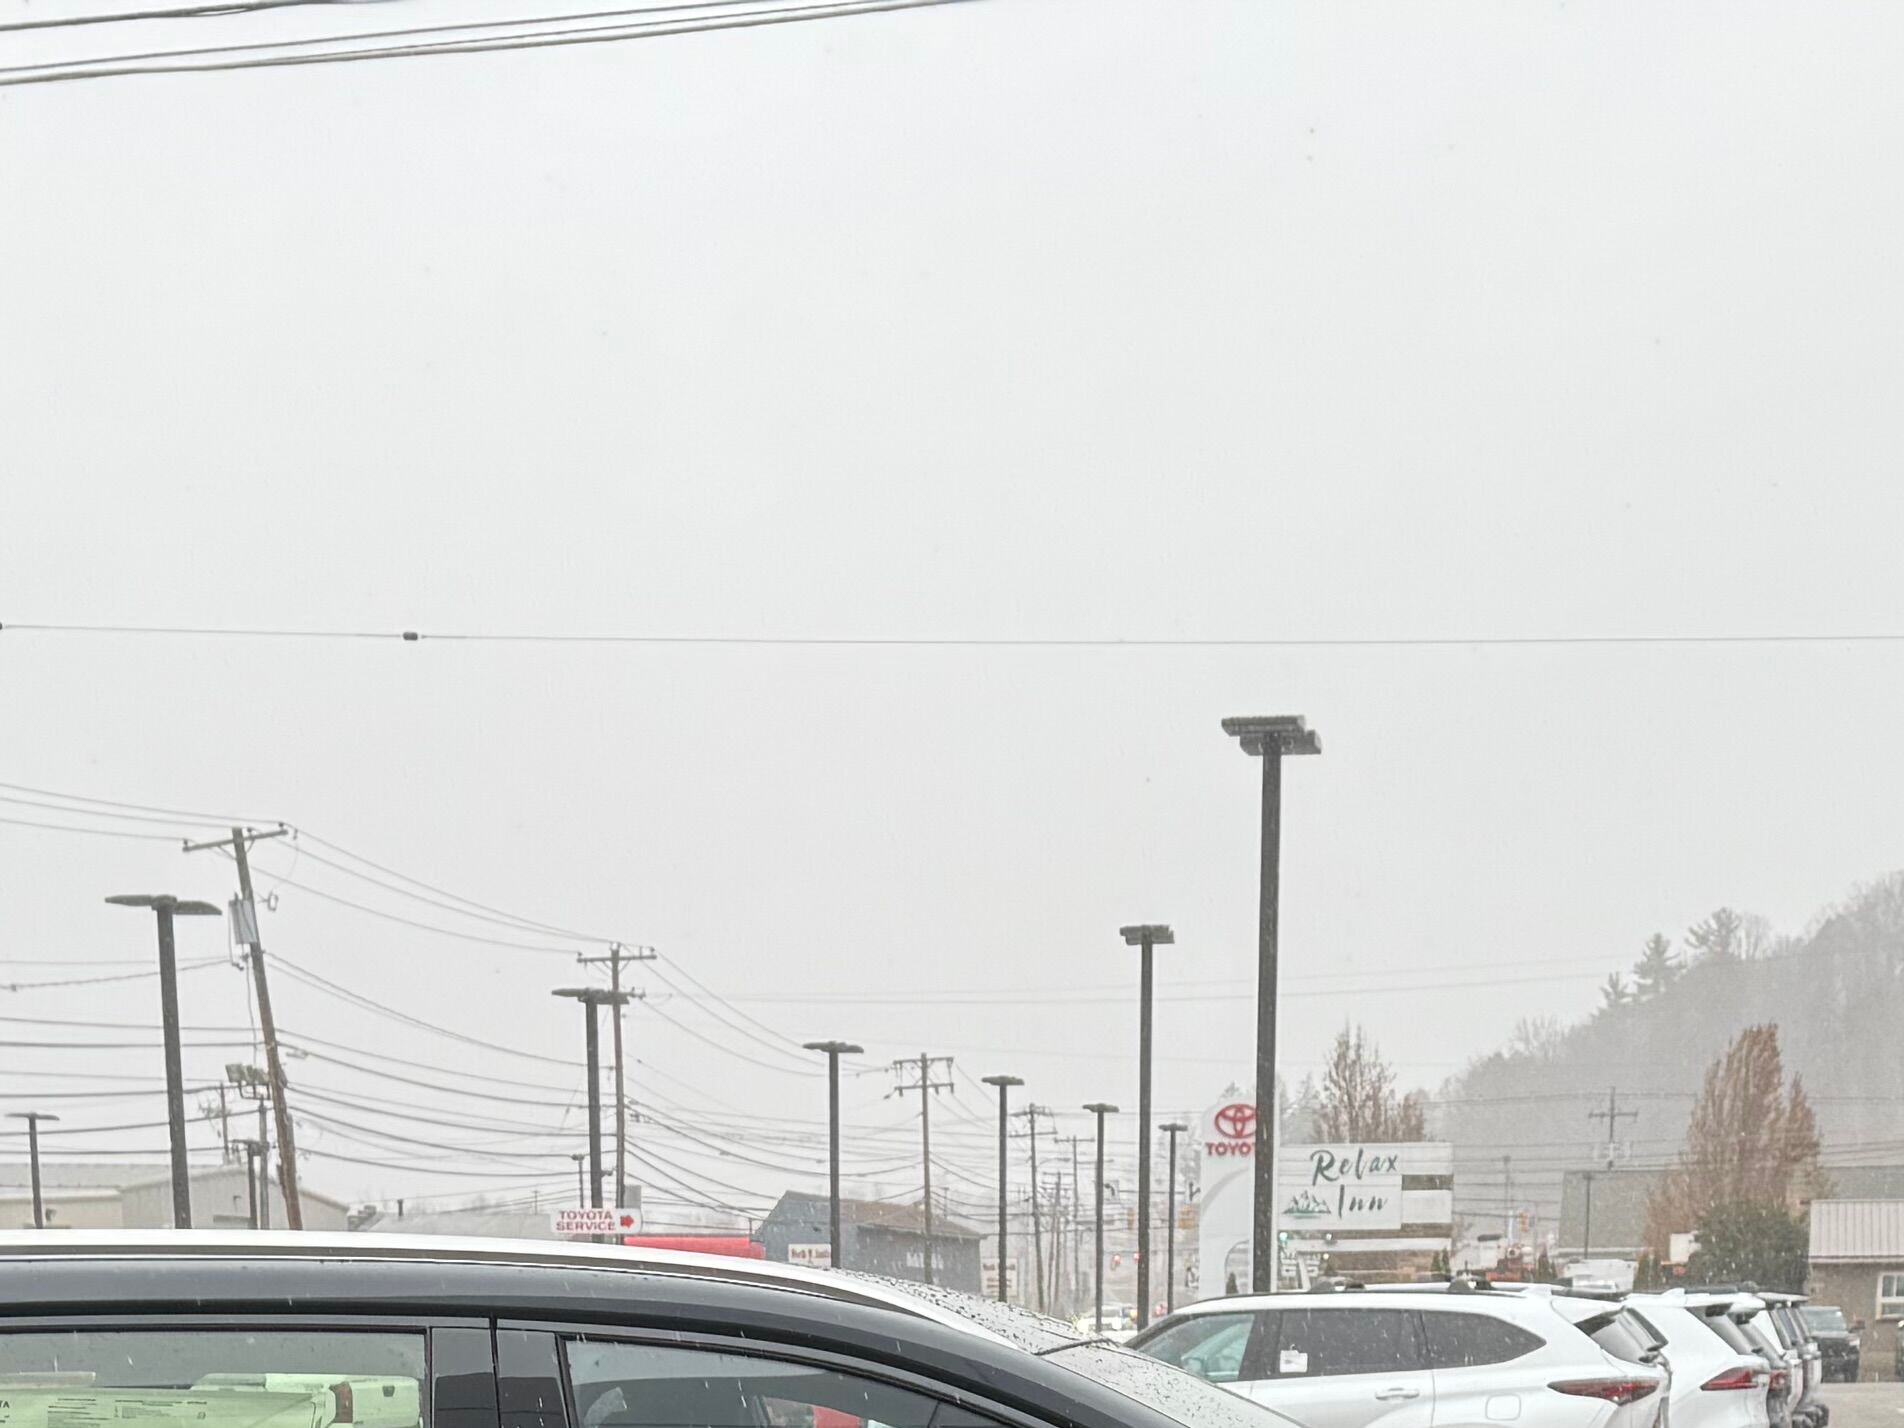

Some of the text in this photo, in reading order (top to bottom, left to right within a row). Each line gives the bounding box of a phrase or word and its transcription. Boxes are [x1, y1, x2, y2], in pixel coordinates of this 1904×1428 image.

[1205, 1141, 1256, 1157] TOYO
[1309, 1147, 1399, 1186] Relax
[1337, 1183, 1389, 1219] Inn
[559, 1210, 613, 1220] TOYOTA
[556, 1221, 616, 1231] SERVICE
